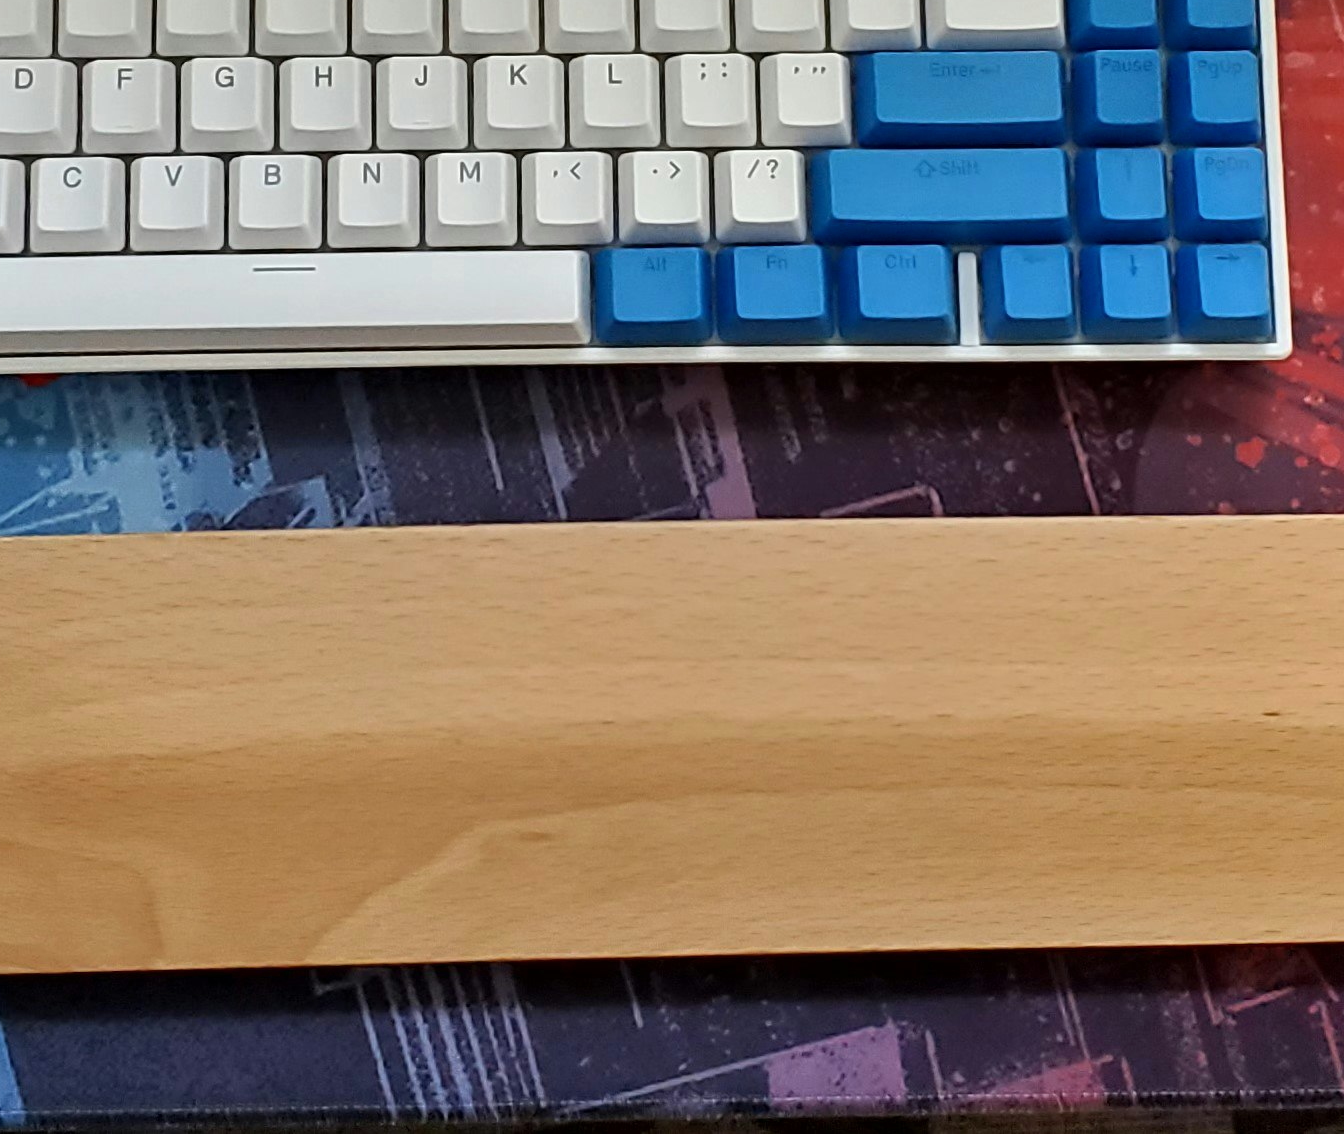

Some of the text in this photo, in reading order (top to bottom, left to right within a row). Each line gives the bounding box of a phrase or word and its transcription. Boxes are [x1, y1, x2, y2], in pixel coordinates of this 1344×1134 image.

[14, 67, 34, 90] D
[117, 67, 133, 91] F
[214, 66, 235, 88] G
[314, 65, 333, 88] H
[414, 64, 428, 87] J
[509, 63, 528, 86] K
[607, 62, 623, 85] L
[62, 166, 82, 189] C
[164, 164, 183, 187] V
[264, 163, 282, 186] B
[362, 161, 381, 184] N
[459, 160, 481, 183] M
